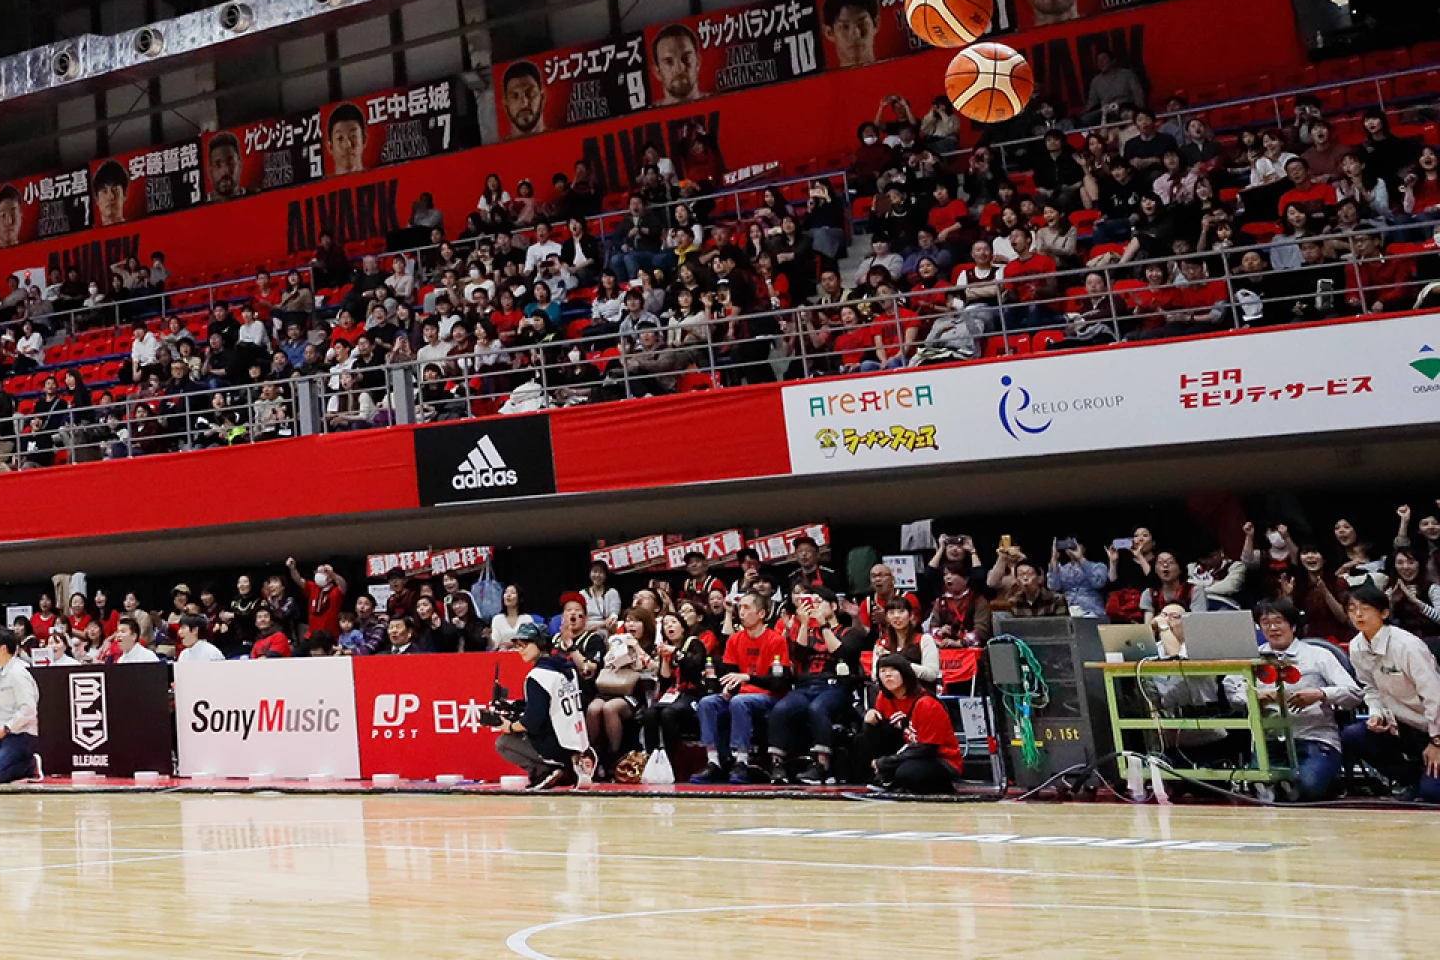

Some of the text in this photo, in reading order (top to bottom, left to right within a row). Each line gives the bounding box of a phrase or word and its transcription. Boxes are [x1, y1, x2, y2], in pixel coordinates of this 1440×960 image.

[365, 81, 452, 126] 正中岳城
[1179, 368, 1242, 390] トヨタ
[1178, 375, 1374, 409] モビリティサービス
[1031, 394, 1125, 416] RELO GROUP
[451, 467, 519, 490] adidas
[371, 729, 419, 739] POST
[1045, 728, 1080, 741] 0.15t
